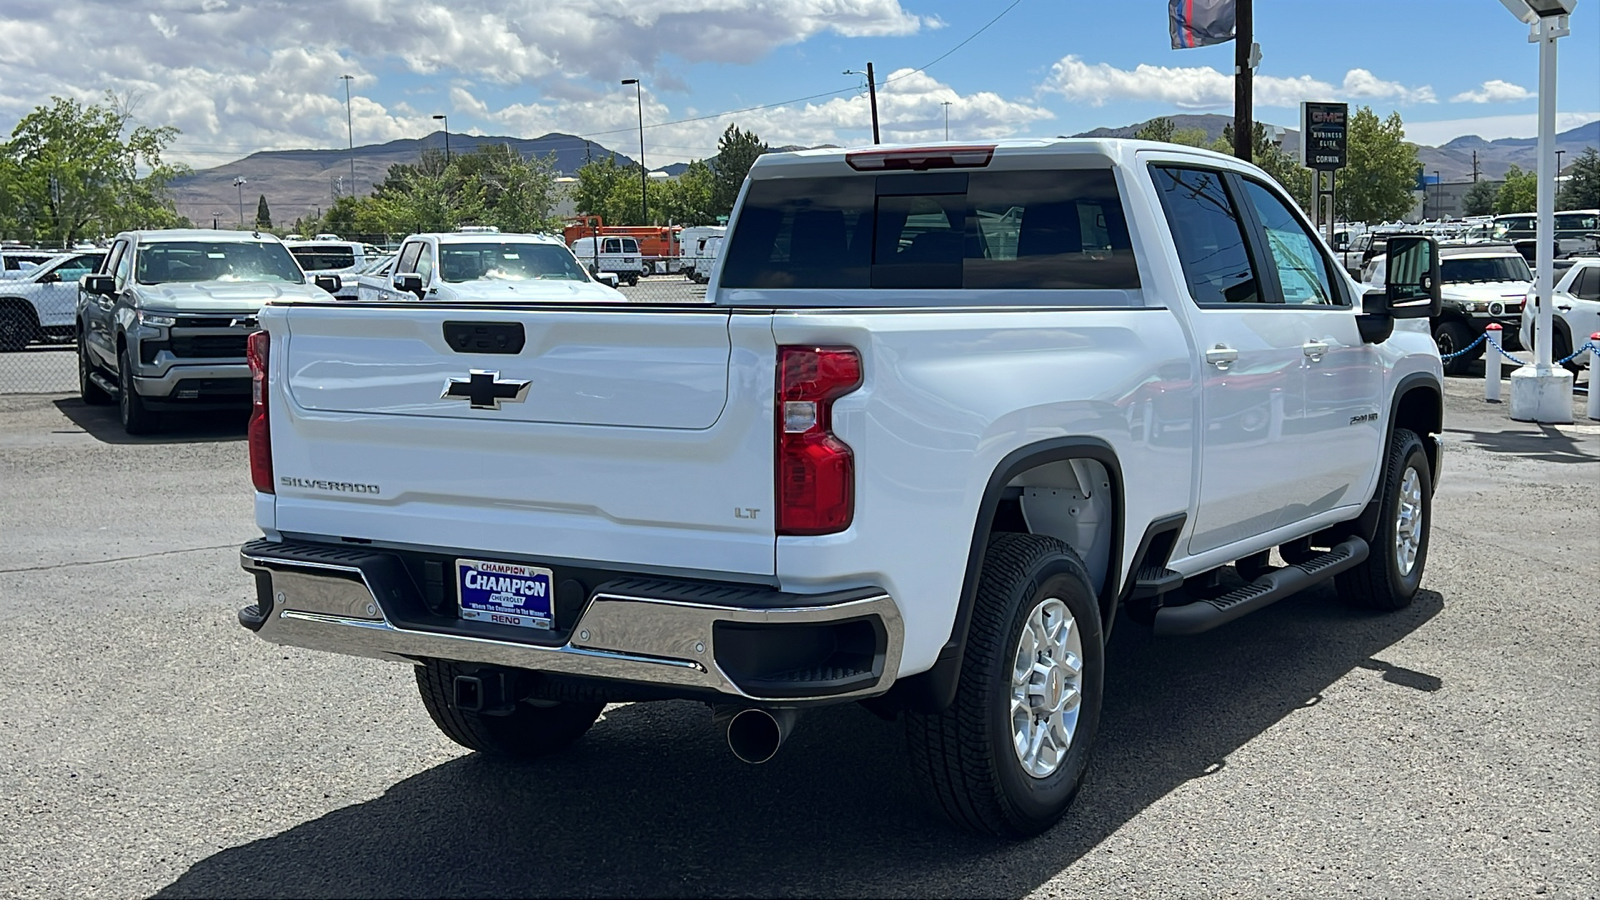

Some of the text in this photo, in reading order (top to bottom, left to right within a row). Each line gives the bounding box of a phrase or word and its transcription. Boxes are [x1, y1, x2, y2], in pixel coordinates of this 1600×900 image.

[1312, 112, 1344, 123] GMC
[1313, 131, 1342, 139] BUSINESS
[1315, 155, 1339, 164] CORWIN
[280, 476, 380, 495] SILVERADO
[734, 507, 760, 519] LT
[481, 563, 526, 575] CHAMPION
[465, 570, 546, 597] CHAMPION
[491, 594, 523, 604] CHEVROLET
[491, 614, 521, 625] RENO
